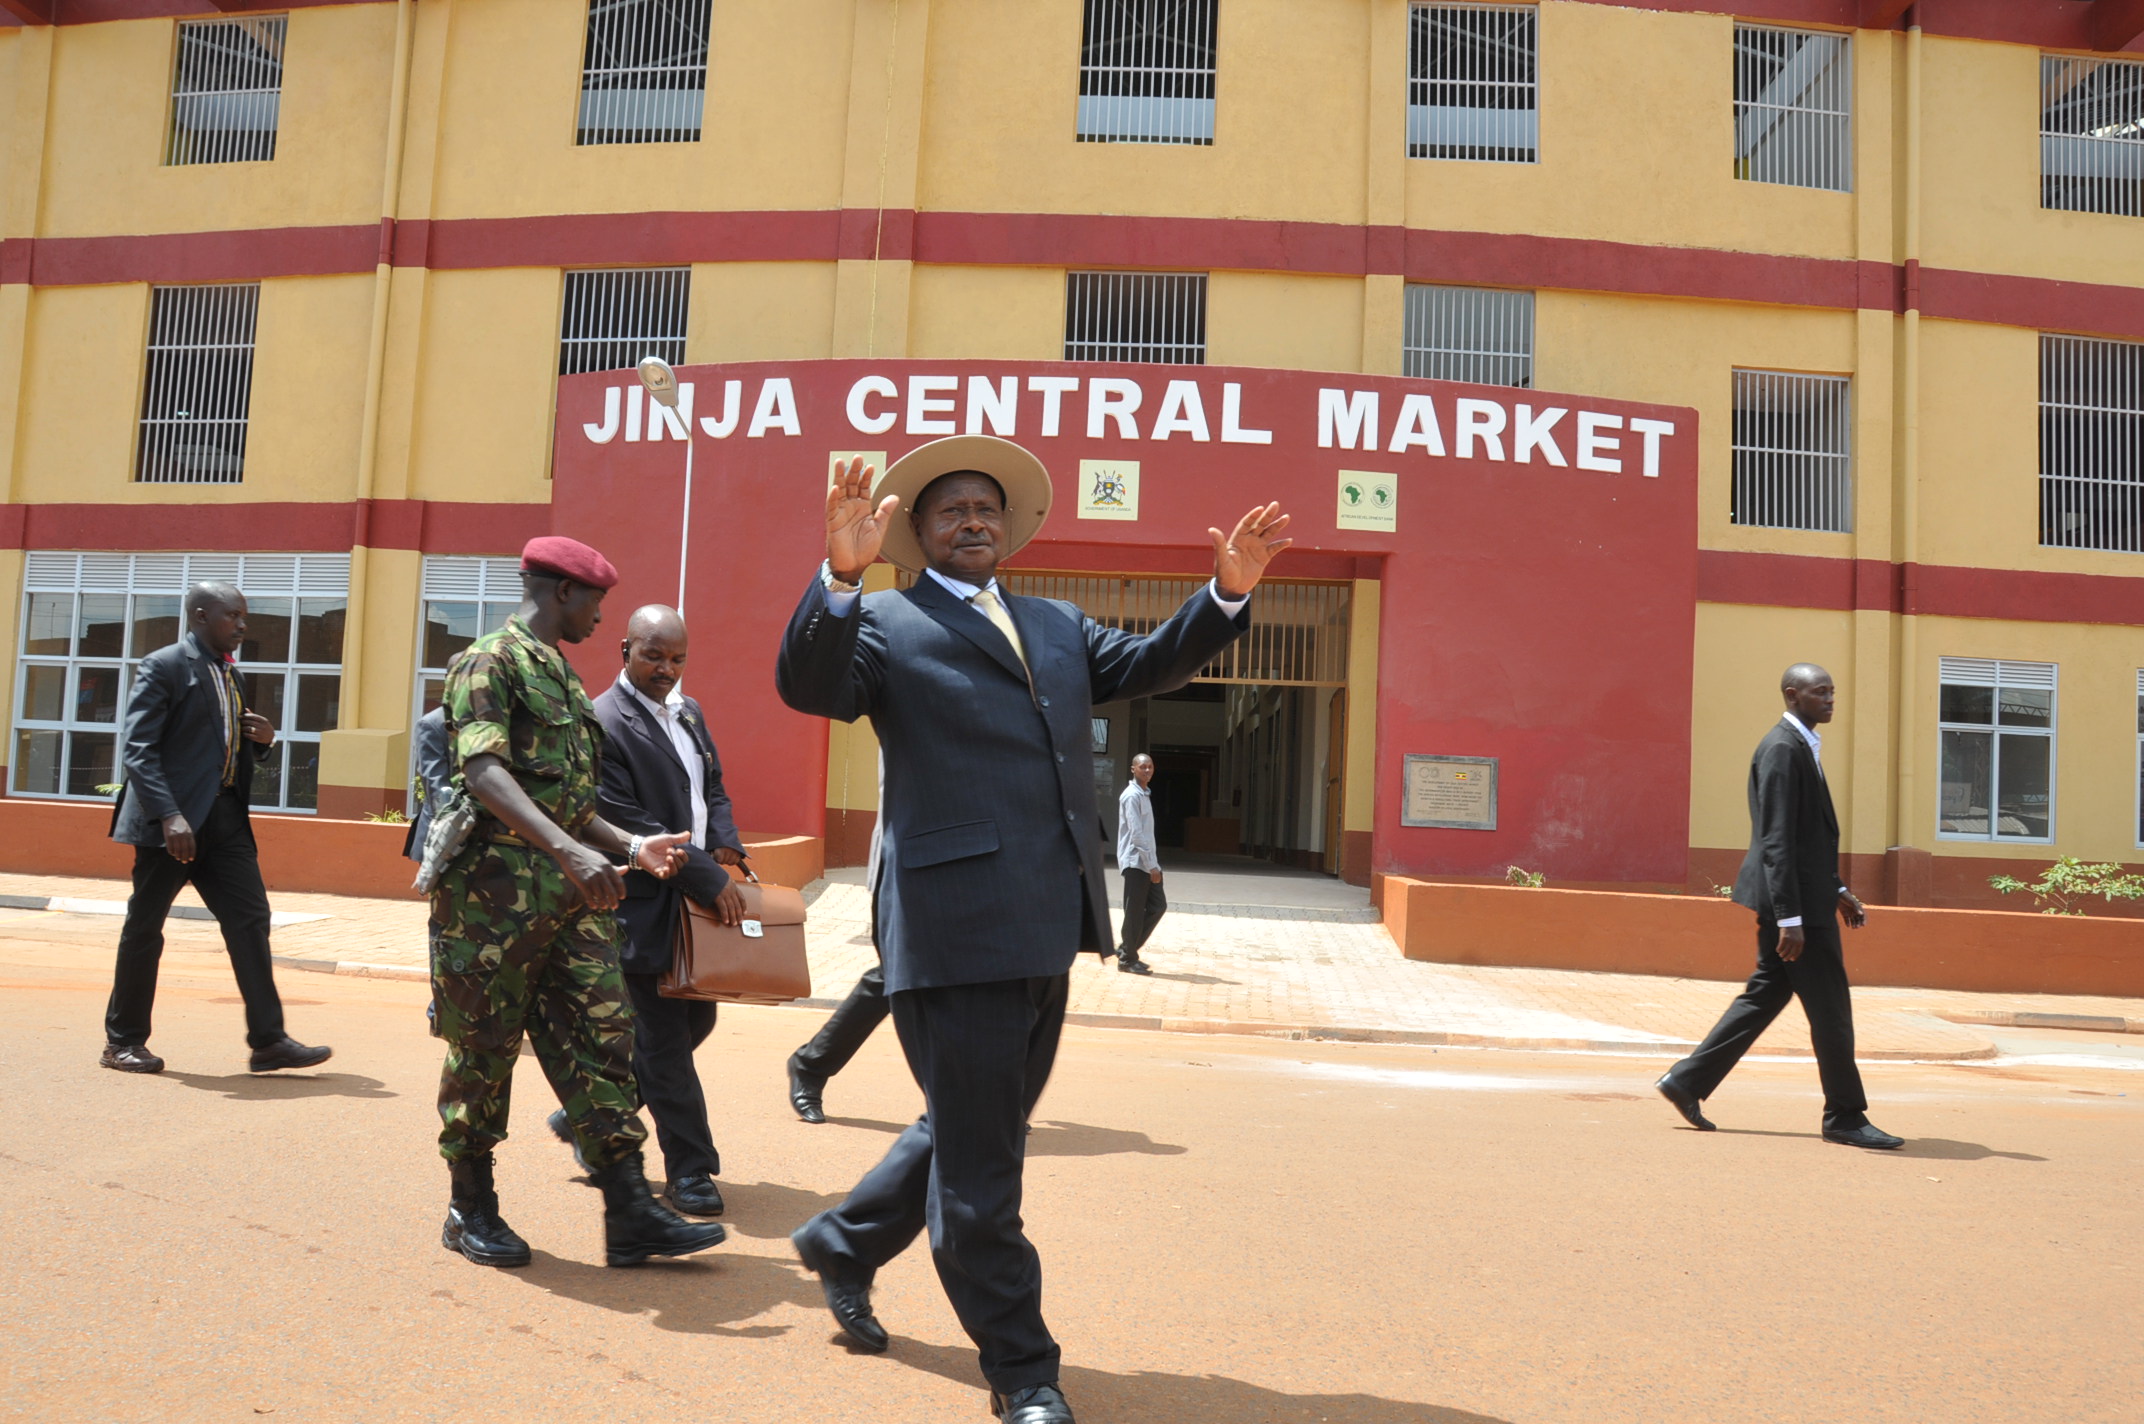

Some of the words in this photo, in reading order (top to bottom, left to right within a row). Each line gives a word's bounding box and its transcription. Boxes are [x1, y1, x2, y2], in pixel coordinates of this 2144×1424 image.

[582, 377, 802, 444] JINJA
[845, 375, 1273, 445] CENTRAL
[1317, 388, 1676, 478] MARKET
